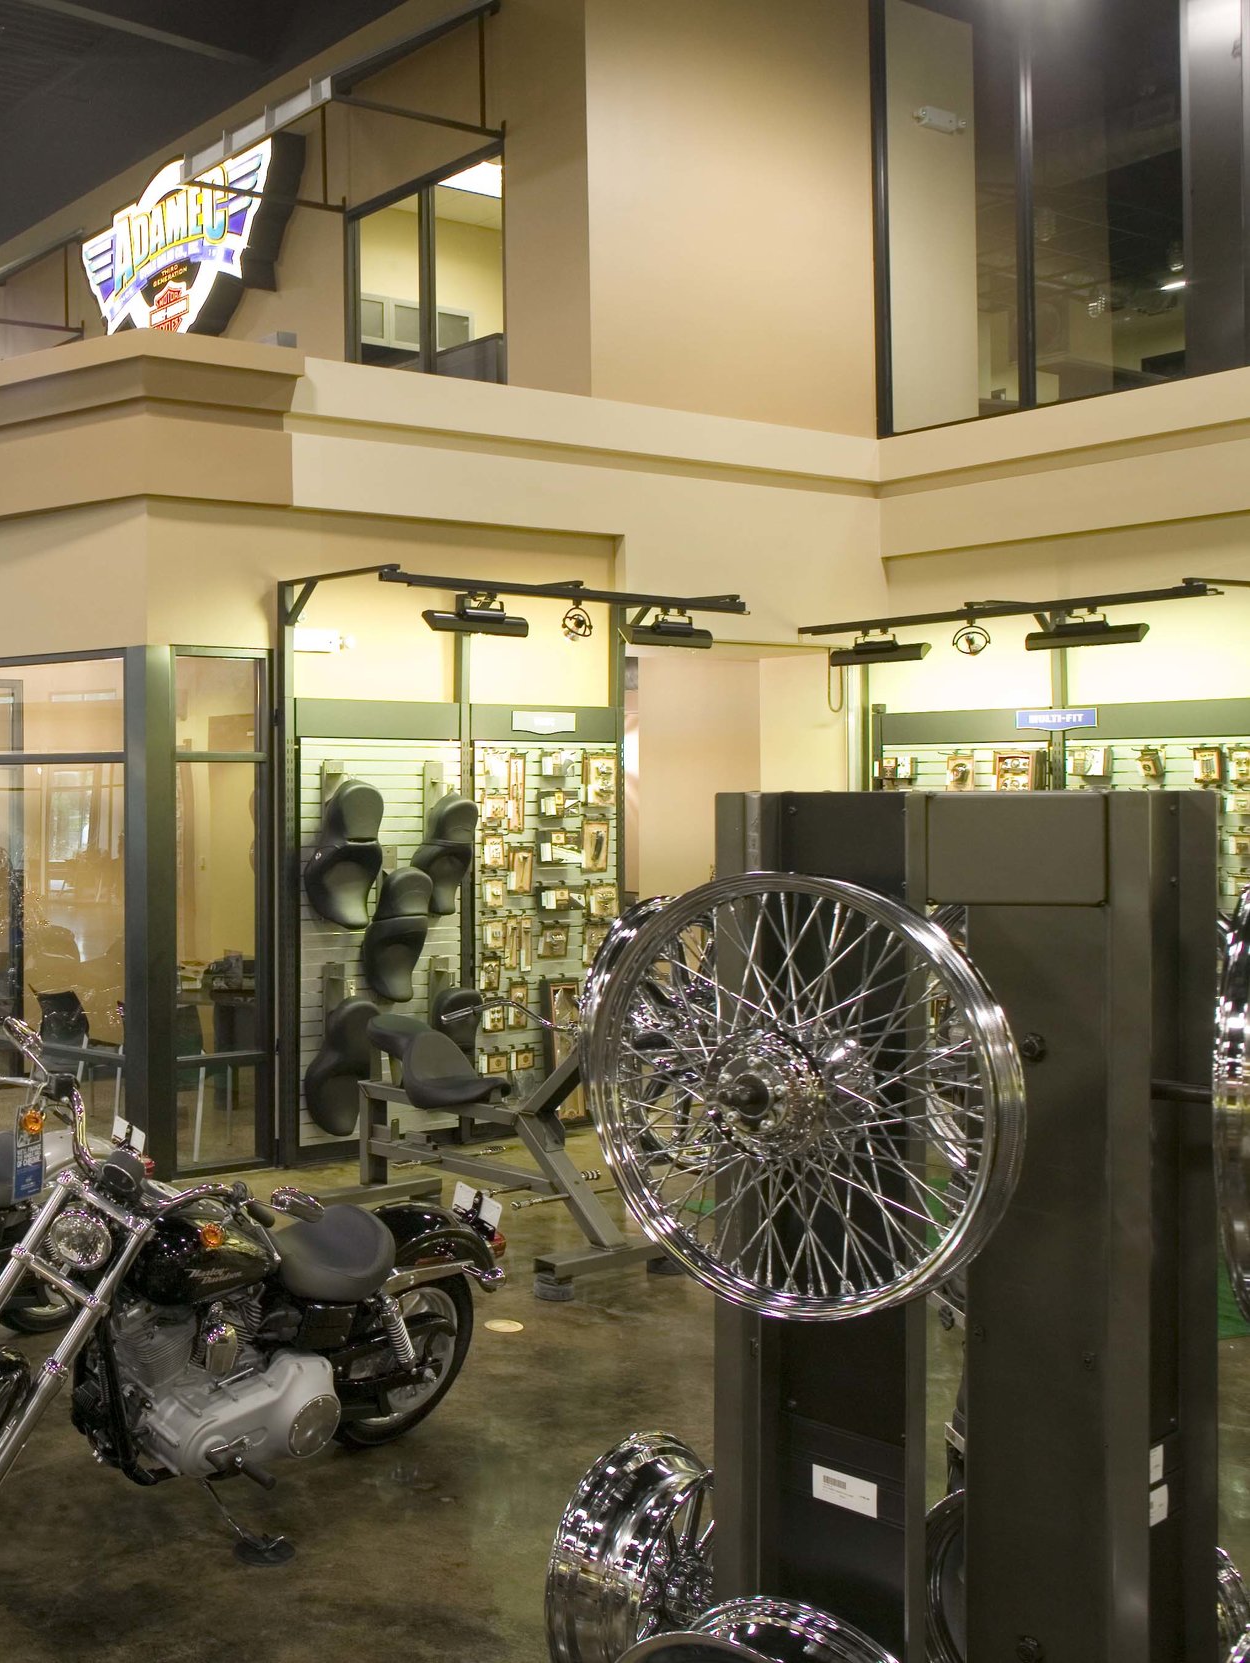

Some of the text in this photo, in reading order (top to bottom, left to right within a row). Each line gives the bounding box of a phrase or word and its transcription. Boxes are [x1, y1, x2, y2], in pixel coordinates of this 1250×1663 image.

[114, 165, 228, 296] ADAMEC
[153, 266, 188, 288] GENERATION
[161, 264, 178, 277] THIRD
